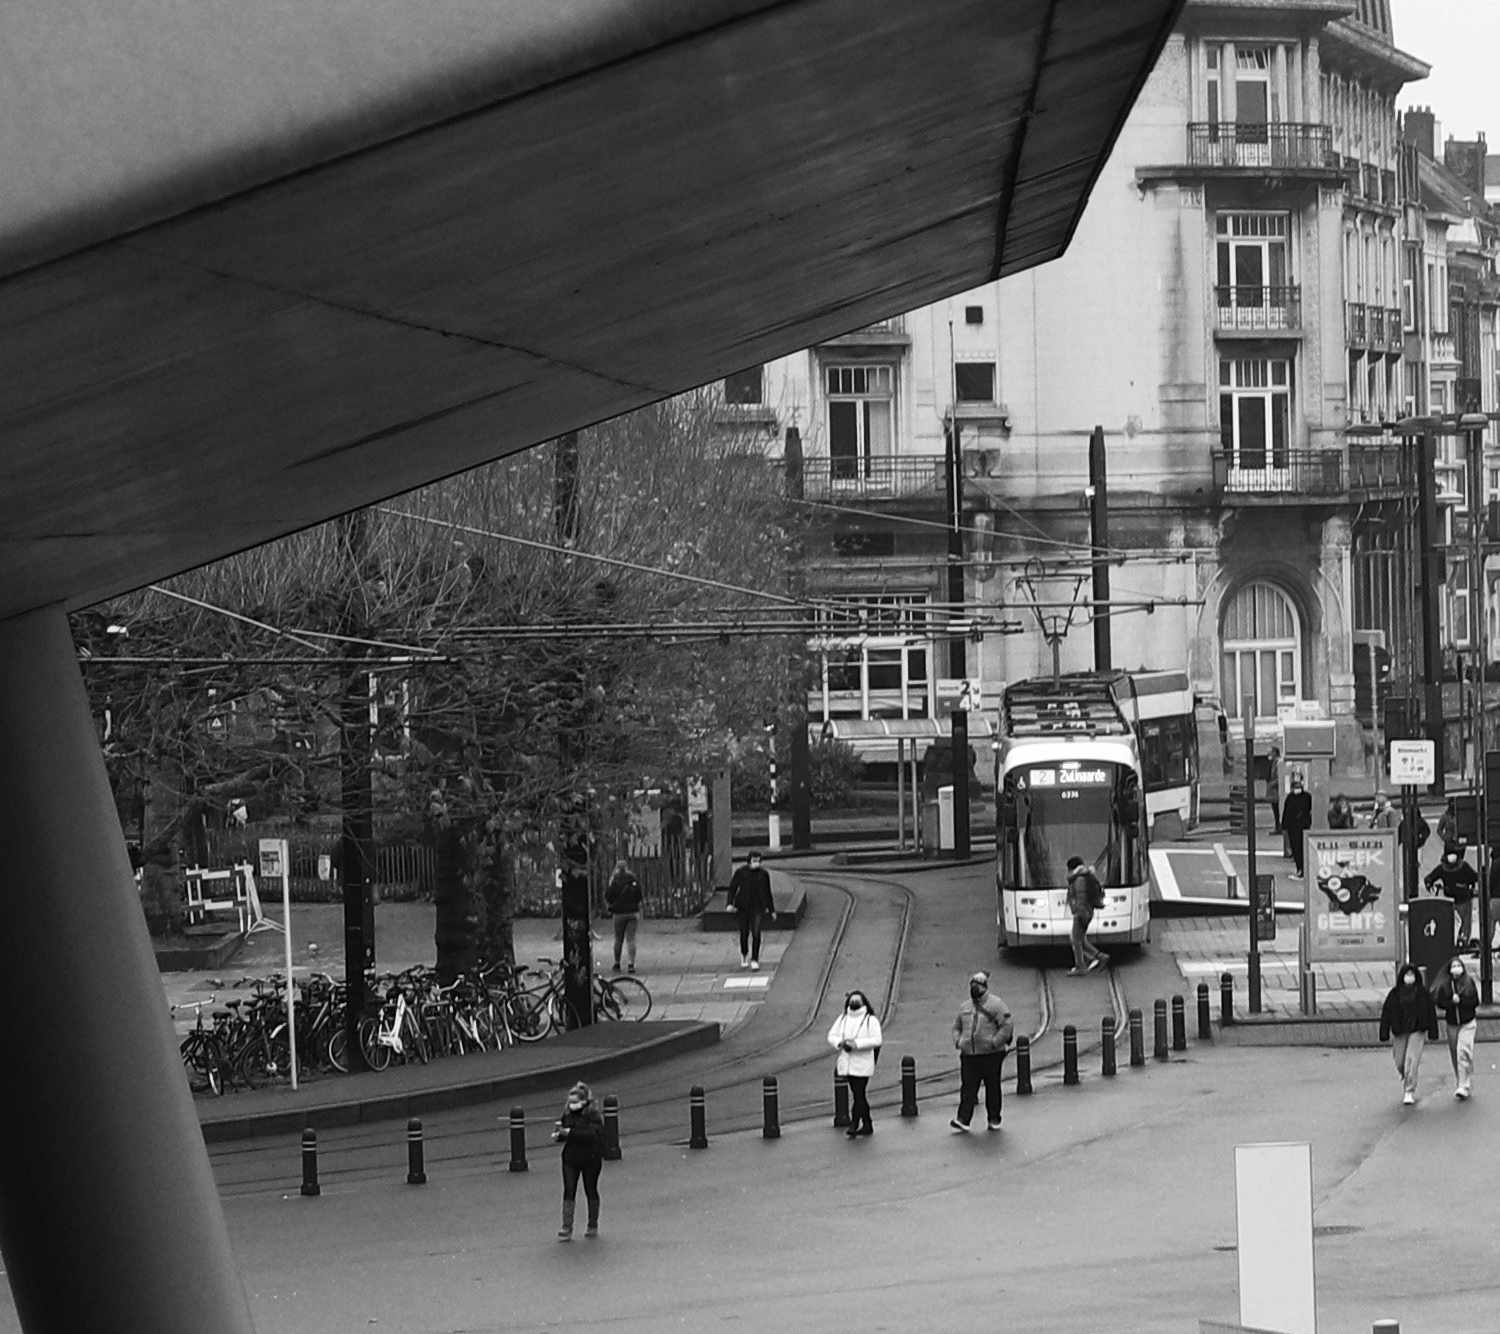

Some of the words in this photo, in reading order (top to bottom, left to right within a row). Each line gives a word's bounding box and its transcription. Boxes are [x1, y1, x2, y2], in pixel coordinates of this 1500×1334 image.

[960, 680, 970, 695] 2
[959, 695, 971, 710] 4
[1039, 769, 1047, 782] 2
[1317, 850, 1384, 866] WEEK
